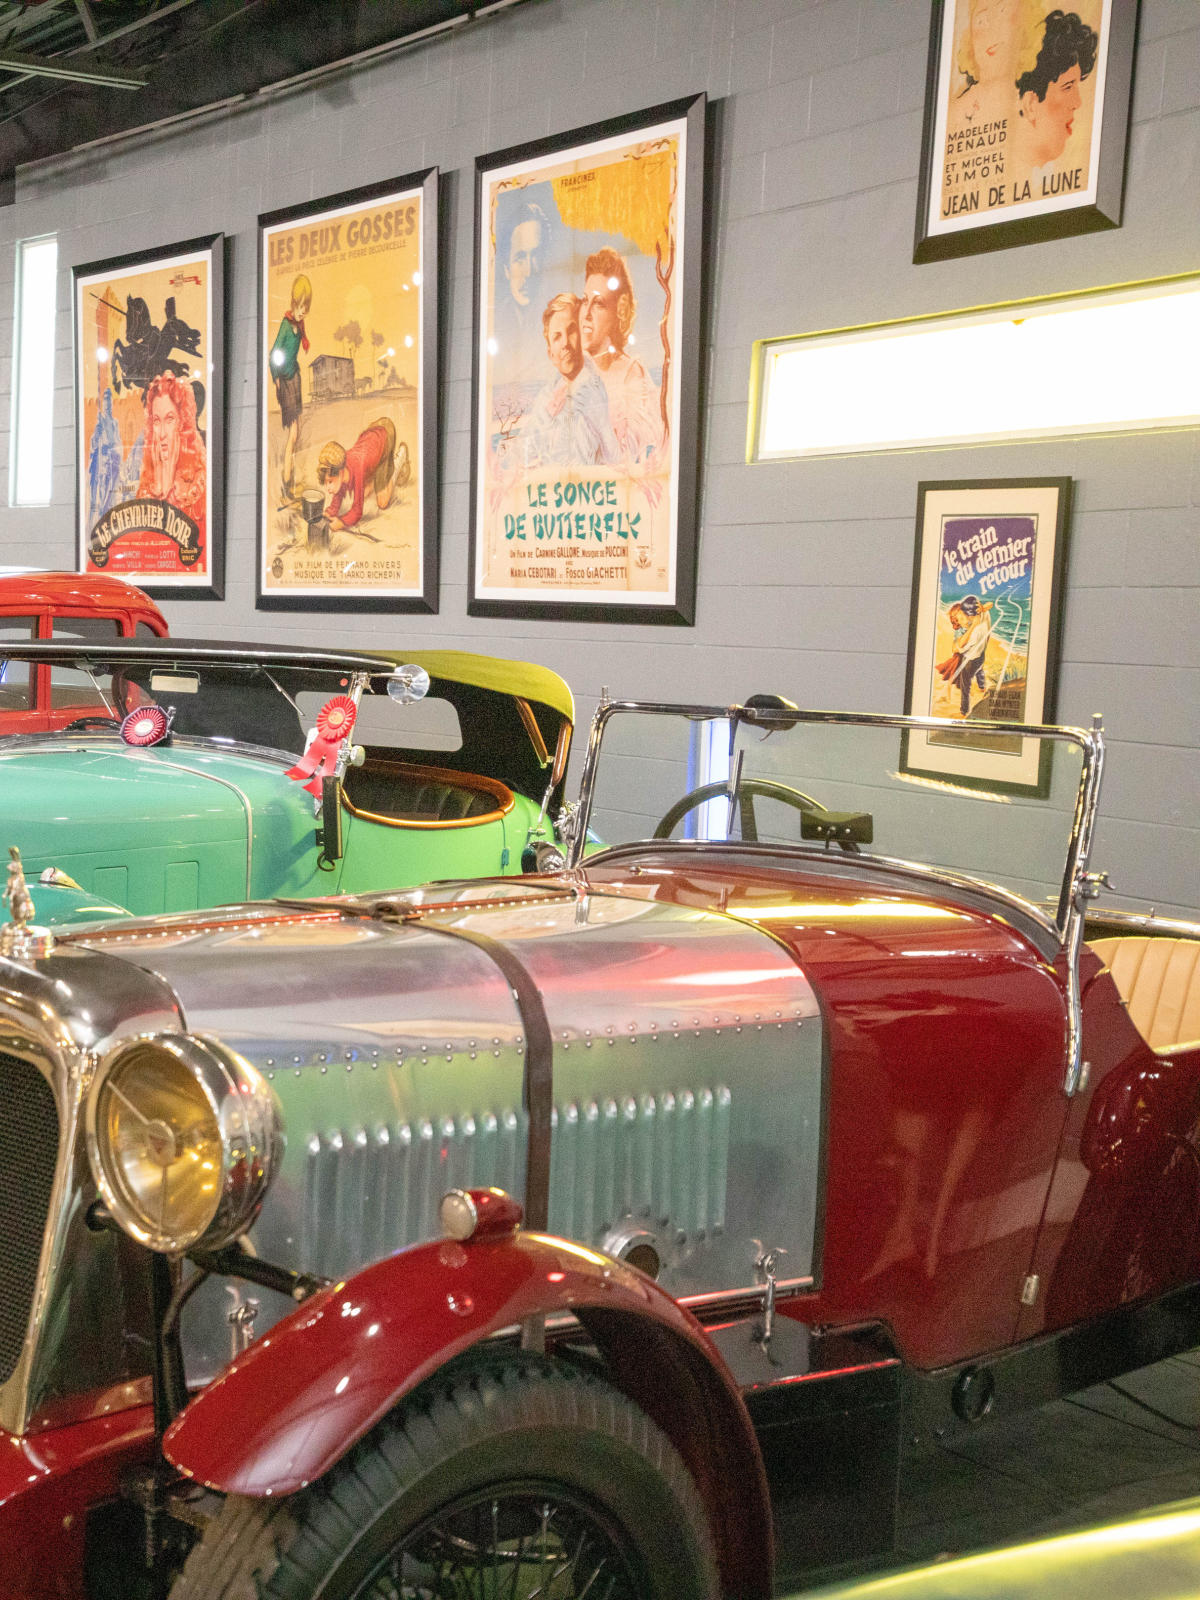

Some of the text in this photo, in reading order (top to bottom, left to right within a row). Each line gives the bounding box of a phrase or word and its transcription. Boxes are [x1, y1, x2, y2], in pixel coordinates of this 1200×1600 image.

[947, 131, 1007, 154] RENAUD
[948, 119, 1008, 142] MADELEINE
[945, 152, 1005, 173] ET MICHEL
[946, 164, 1005, 186] SIMON
[943, 168, 1082, 216] JEAN DE LA LUNE
[270, 206, 416, 267] LES DEUX GOSSES
[527, 480, 618, 508] LE SONGE
[95, 522, 112, 548] LE
[110, 504, 164, 537] CHEVALIER
[504, 511, 642, 543] DE BUTTERFLY
[605, 546, 629, 558] PUCCINI
[944, 526, 998, 573] le train
[955, 535, 1032, 585] du dernier
[294, 570, 325, 580] MUSIQUE
[327, 570, 337, 579] DE
[367, 570, 401, 579] RICHEPIN
[373, 560, 401, 569] RIVERS
[528, 567, 557, 579] CEBOTARI
[978, 557, 1029, 595] retour
